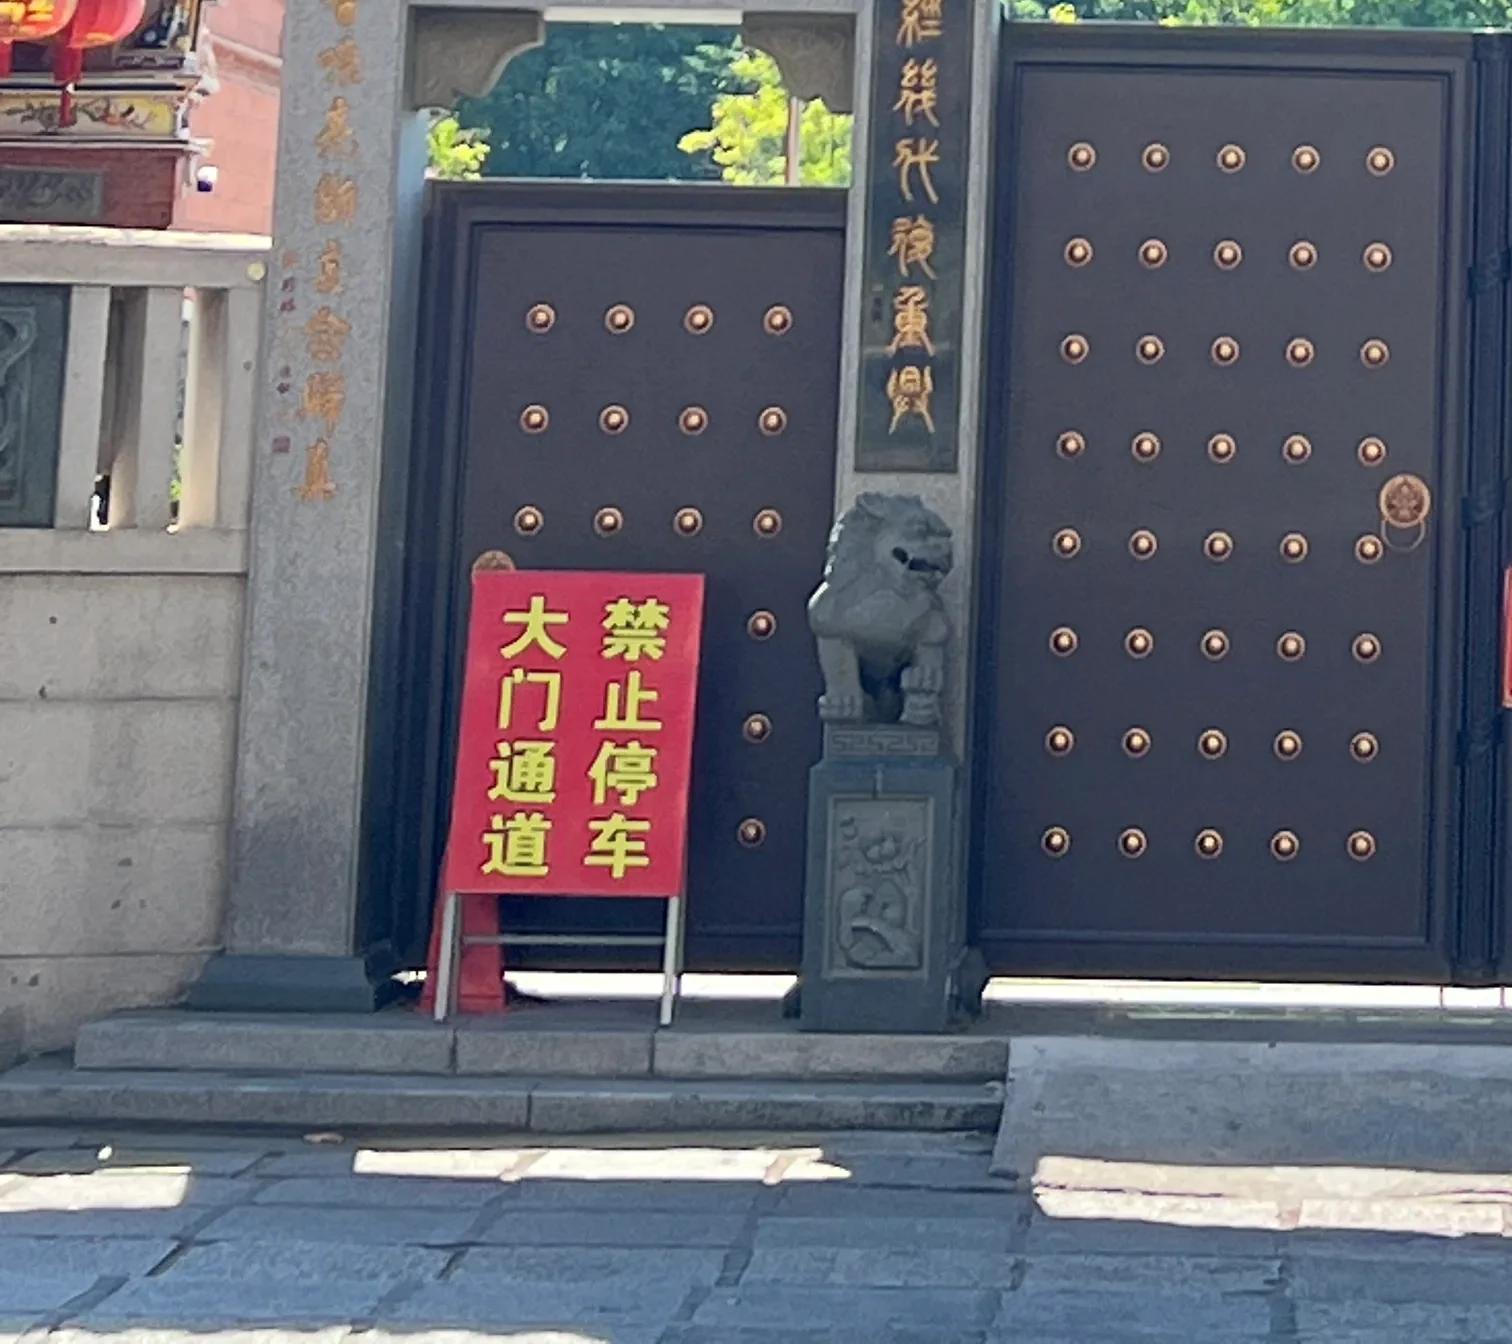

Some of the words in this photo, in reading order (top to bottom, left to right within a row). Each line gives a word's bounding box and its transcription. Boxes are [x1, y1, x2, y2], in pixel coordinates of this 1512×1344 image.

[480, 593, 570, 878] 大门通道
[583, 596, 671, 880] 禁止停车
